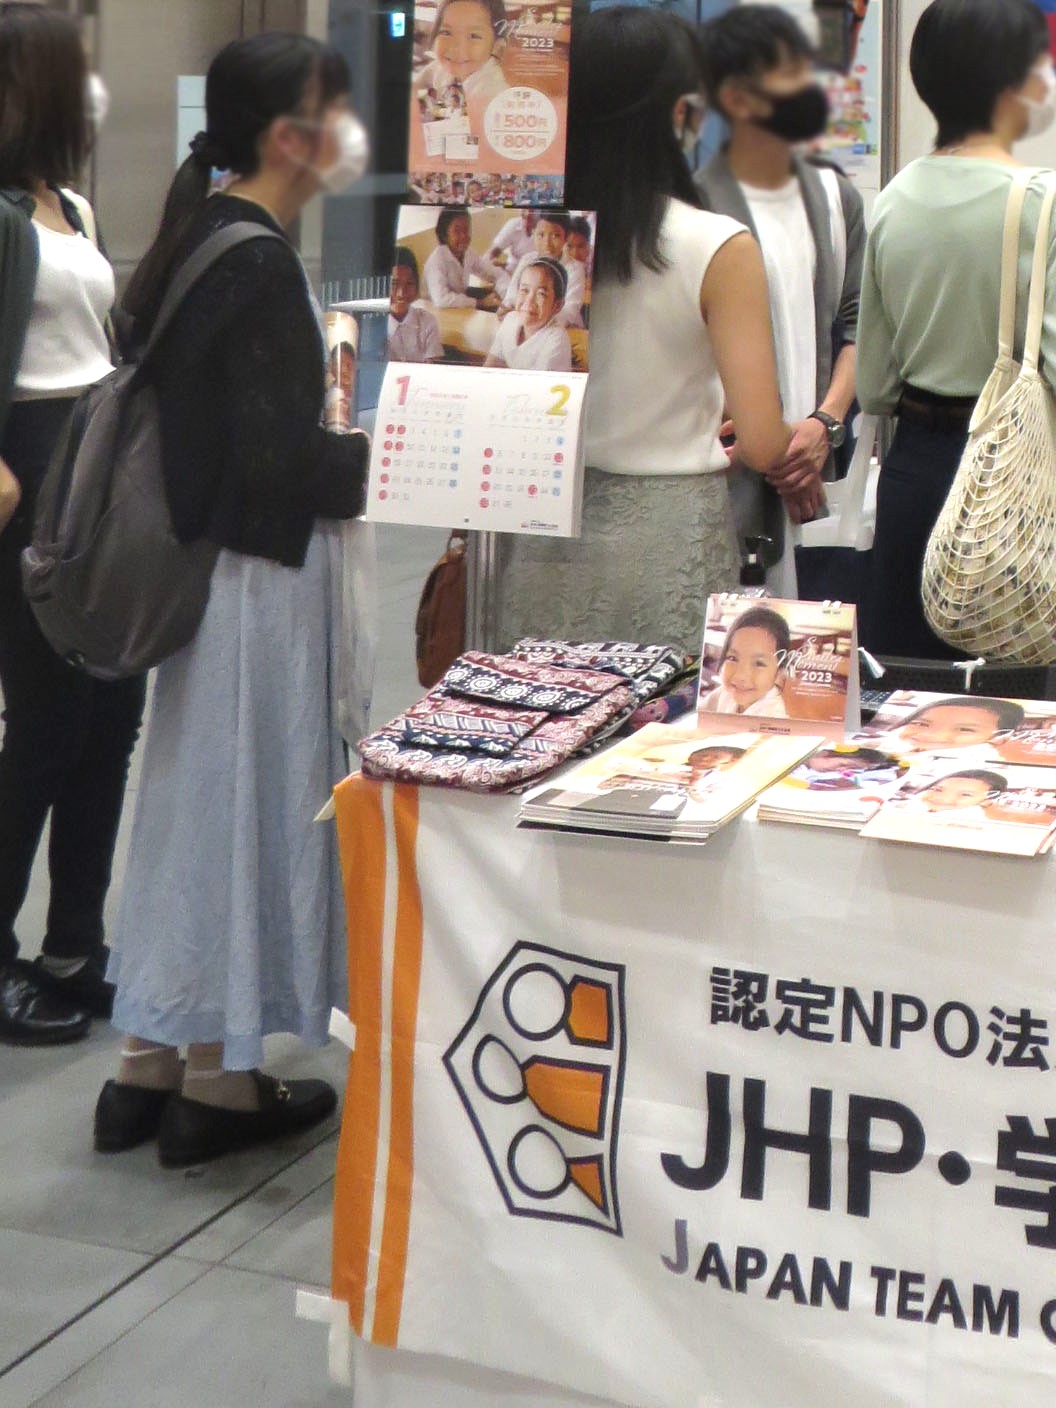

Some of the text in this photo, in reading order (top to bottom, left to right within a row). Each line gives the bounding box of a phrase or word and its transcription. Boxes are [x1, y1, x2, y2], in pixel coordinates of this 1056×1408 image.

[522, 38, 554, 48] 2023
[396, 375, 411, 406] 1
[546, 384, 571, 417] 2
[801, 671, 833, 683] 2023
[660, 1218, 852, 1311] JAPAN
[870, 1266, 1019, 1339] TEAM
